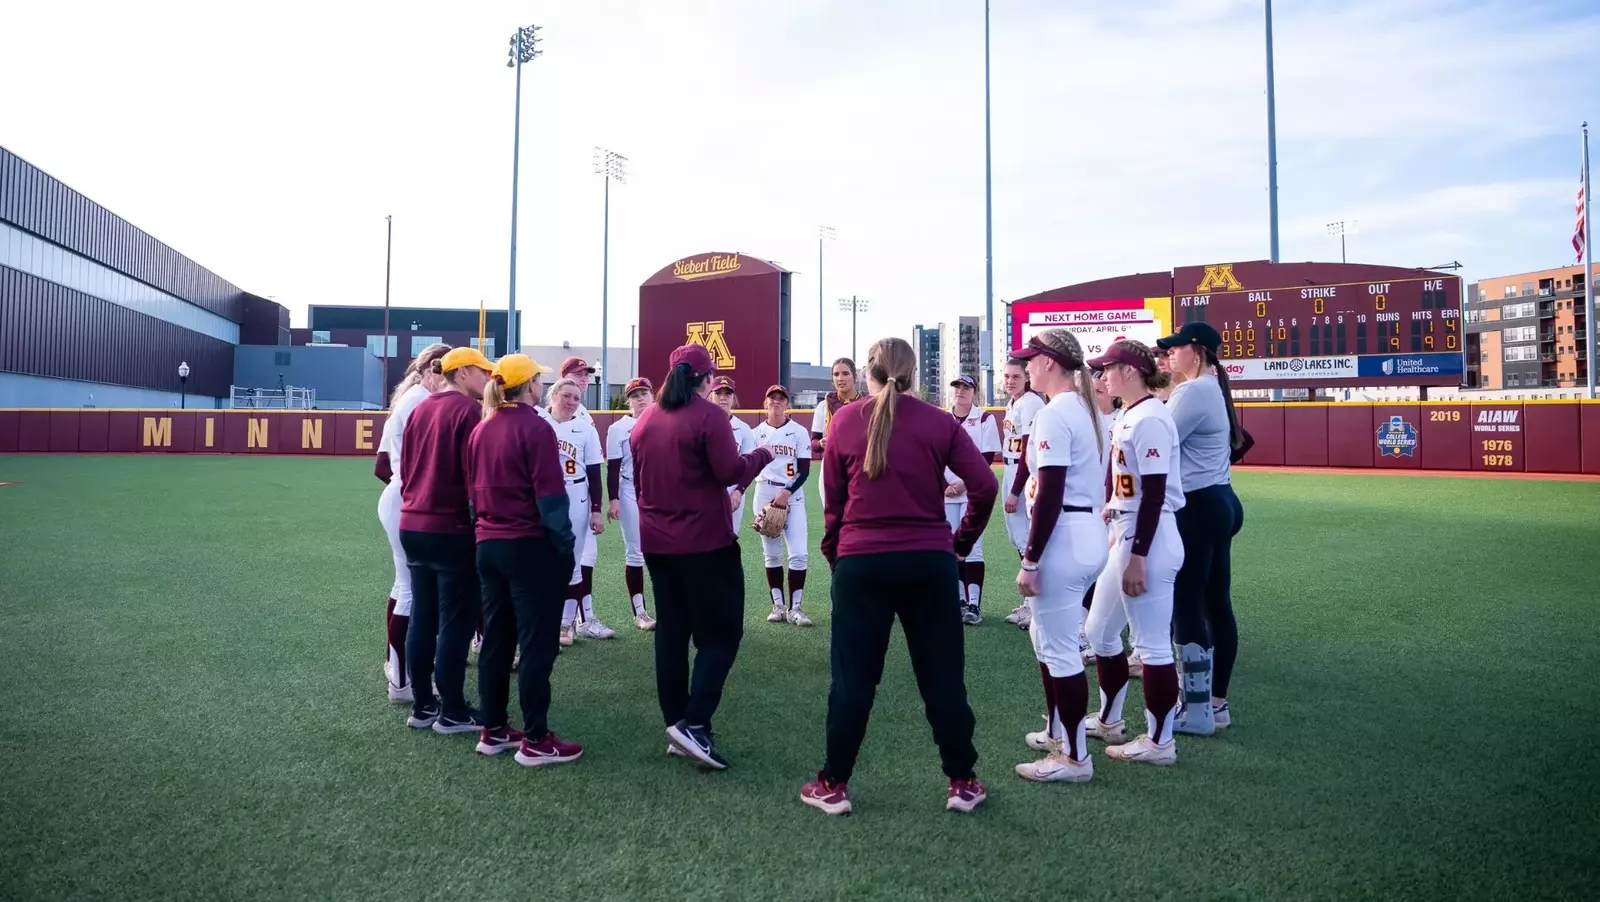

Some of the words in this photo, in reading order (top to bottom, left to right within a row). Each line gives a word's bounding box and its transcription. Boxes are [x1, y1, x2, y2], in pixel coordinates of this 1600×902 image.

[673, 257, 710, 276] Siebert
[711, 254, 741, 272] Field
[1368, 283, 1391, 294] OUT
[1424, 280, 1443, 291] H/E
[1248, 292, 1273, 302] BALL
[1301, 287, 1336, 299] STRIKE
[1181, 297, 1191, 307] AT
[1193, 295, 1211, 306] BAT
[1256, 302, 1266, 318] 0
[1314, 298, 1324, 314] 0
[1375, 294, 1386, 311] 0
[1045, 313, 1071, 322] NEXT
[1074, 312, 1104, 321] HOME
[1107, 311, 1137, 320] GAME
[1235, 321, 1241, 329] 2
[1247, 320, 1253, 329] 3
[1266, 319, 1272, 328] 4
[1278, 318, 1284, 327] 5
[1291, 318, 1297, 326] 6
[1312, 317, 1317, 325] 7
[1325, 316, 1330, 325] 8
[1338, 315, 1343, 324] 9
[1357, 314, 1366, 323] 10
[1376, 312, 1400, 322] RUNS
[1412, 311, 1432, 320] HITS
[1441, 309, 1460, 318] ERR
[1096, 325, 1119, 333] APRIL
[1222, 330, 1230, 343] 0
[1235, 329, 1242, 342] 0
[1247, 328, 1254, 341] 0
[1278, 327, 1286, 340] 0
[1446, 320, 1455, 332] 4
[1087, 345, 1102, 353] VS
[1223, 345, 1230, 357] 3
[1235, 344, 1243, 356] 3
[1247, 344, 1255, 356] 2
[1391, 337, 1400, 350] 9
[1424, 336, 1434, 348] 9
[1446, 335, 1456, 349] 0
[1264, 361, 1288, 371] LAND
[1334, 358, 1353, 369] INC.
[1397, 365, 1439, 374] Healthcare
[1430, 410, 1460, 422] 2019
[1477, 410, 1519, 423] AIAW
[1008, 437, 1022, 453] 17
[1482, 439, 1513, 451] 1976
[1482, 455, 1513, 466] 1978
[565, 459, 576, 475] 8
[786, 463, 796, 478] 5
[1115, 473, 1136, 499] 19
